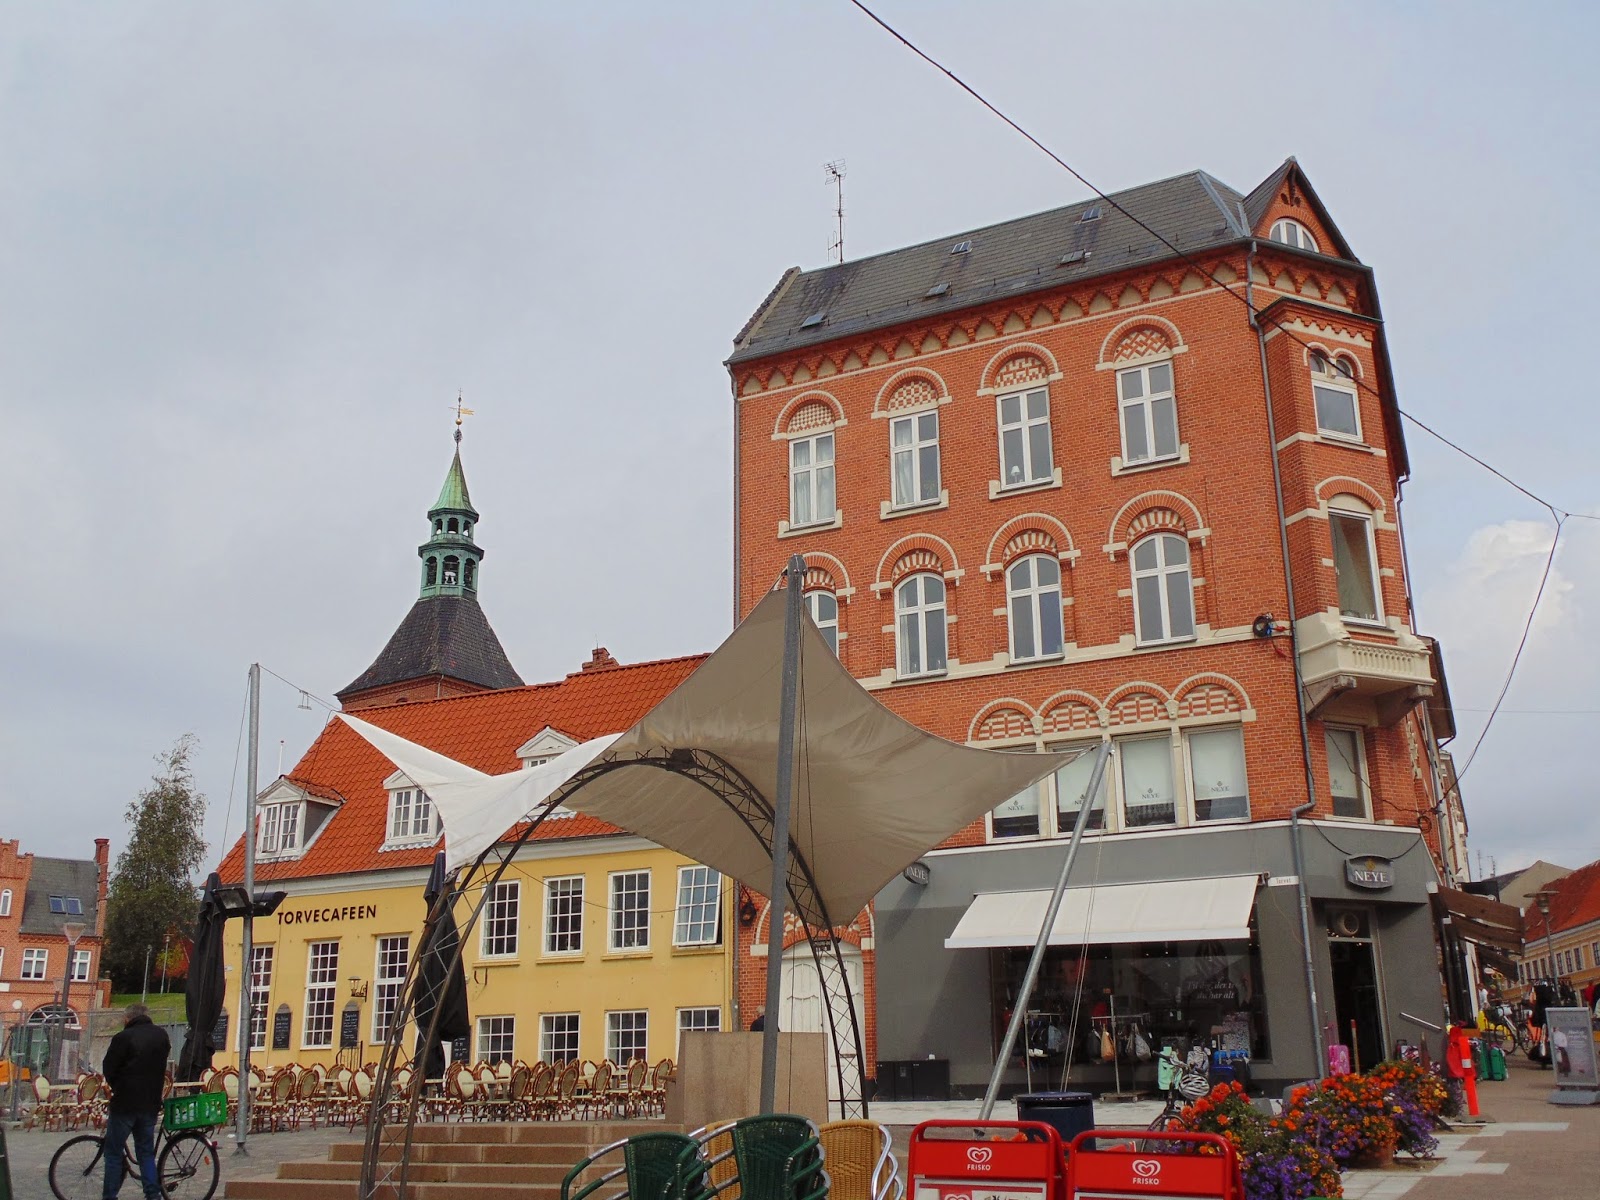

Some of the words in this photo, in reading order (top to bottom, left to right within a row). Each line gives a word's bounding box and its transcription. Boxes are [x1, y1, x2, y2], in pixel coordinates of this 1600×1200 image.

[1353, 870, 1388, 882] NEYE
[277, 904, 377, 925] TORVECAFEEN
[1223, 990, 1235, 999] alt
[1132, 1177, 1160, 1185] FRISKO
